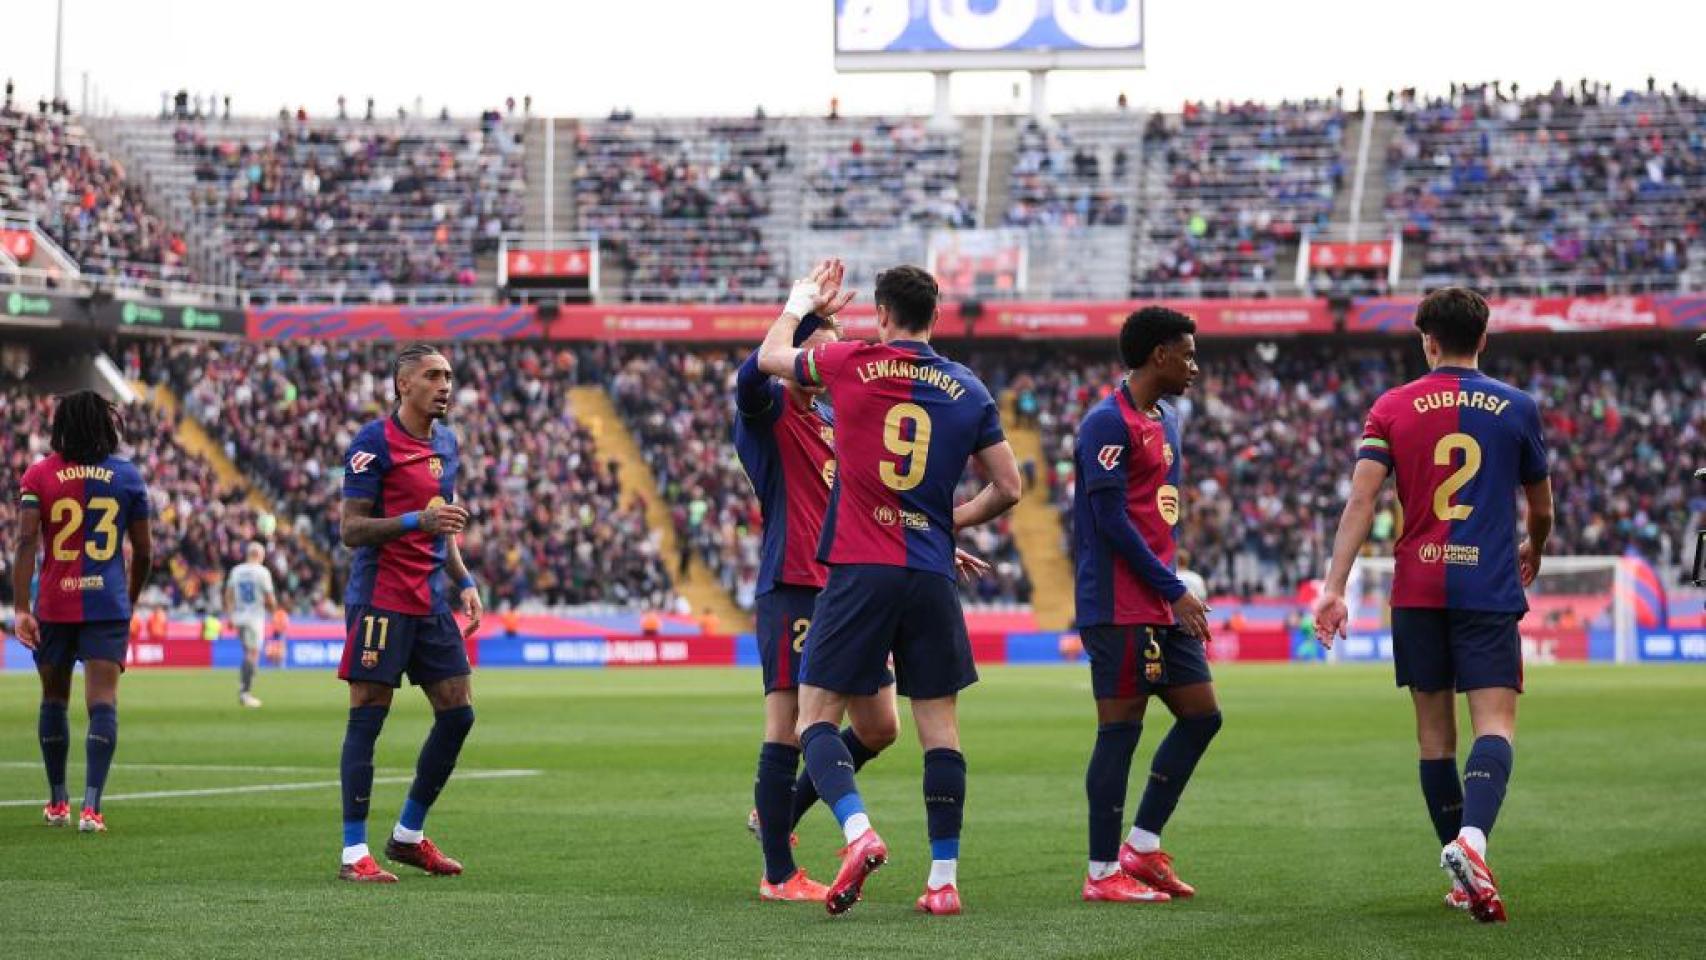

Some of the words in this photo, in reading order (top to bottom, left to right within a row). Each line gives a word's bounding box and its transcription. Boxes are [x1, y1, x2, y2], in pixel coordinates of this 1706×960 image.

[857, 359, 965, 400] LEWANDOWSKI
[879, 402, 932, 490] 9
[56, 465, 114, 483] KOUNDE
[1433, 432, 1482, 520] 2
[51, 497, 119, 561] 23
[363, 615, 388, 650] 11
[1144, 625, 1161, 659] 3
